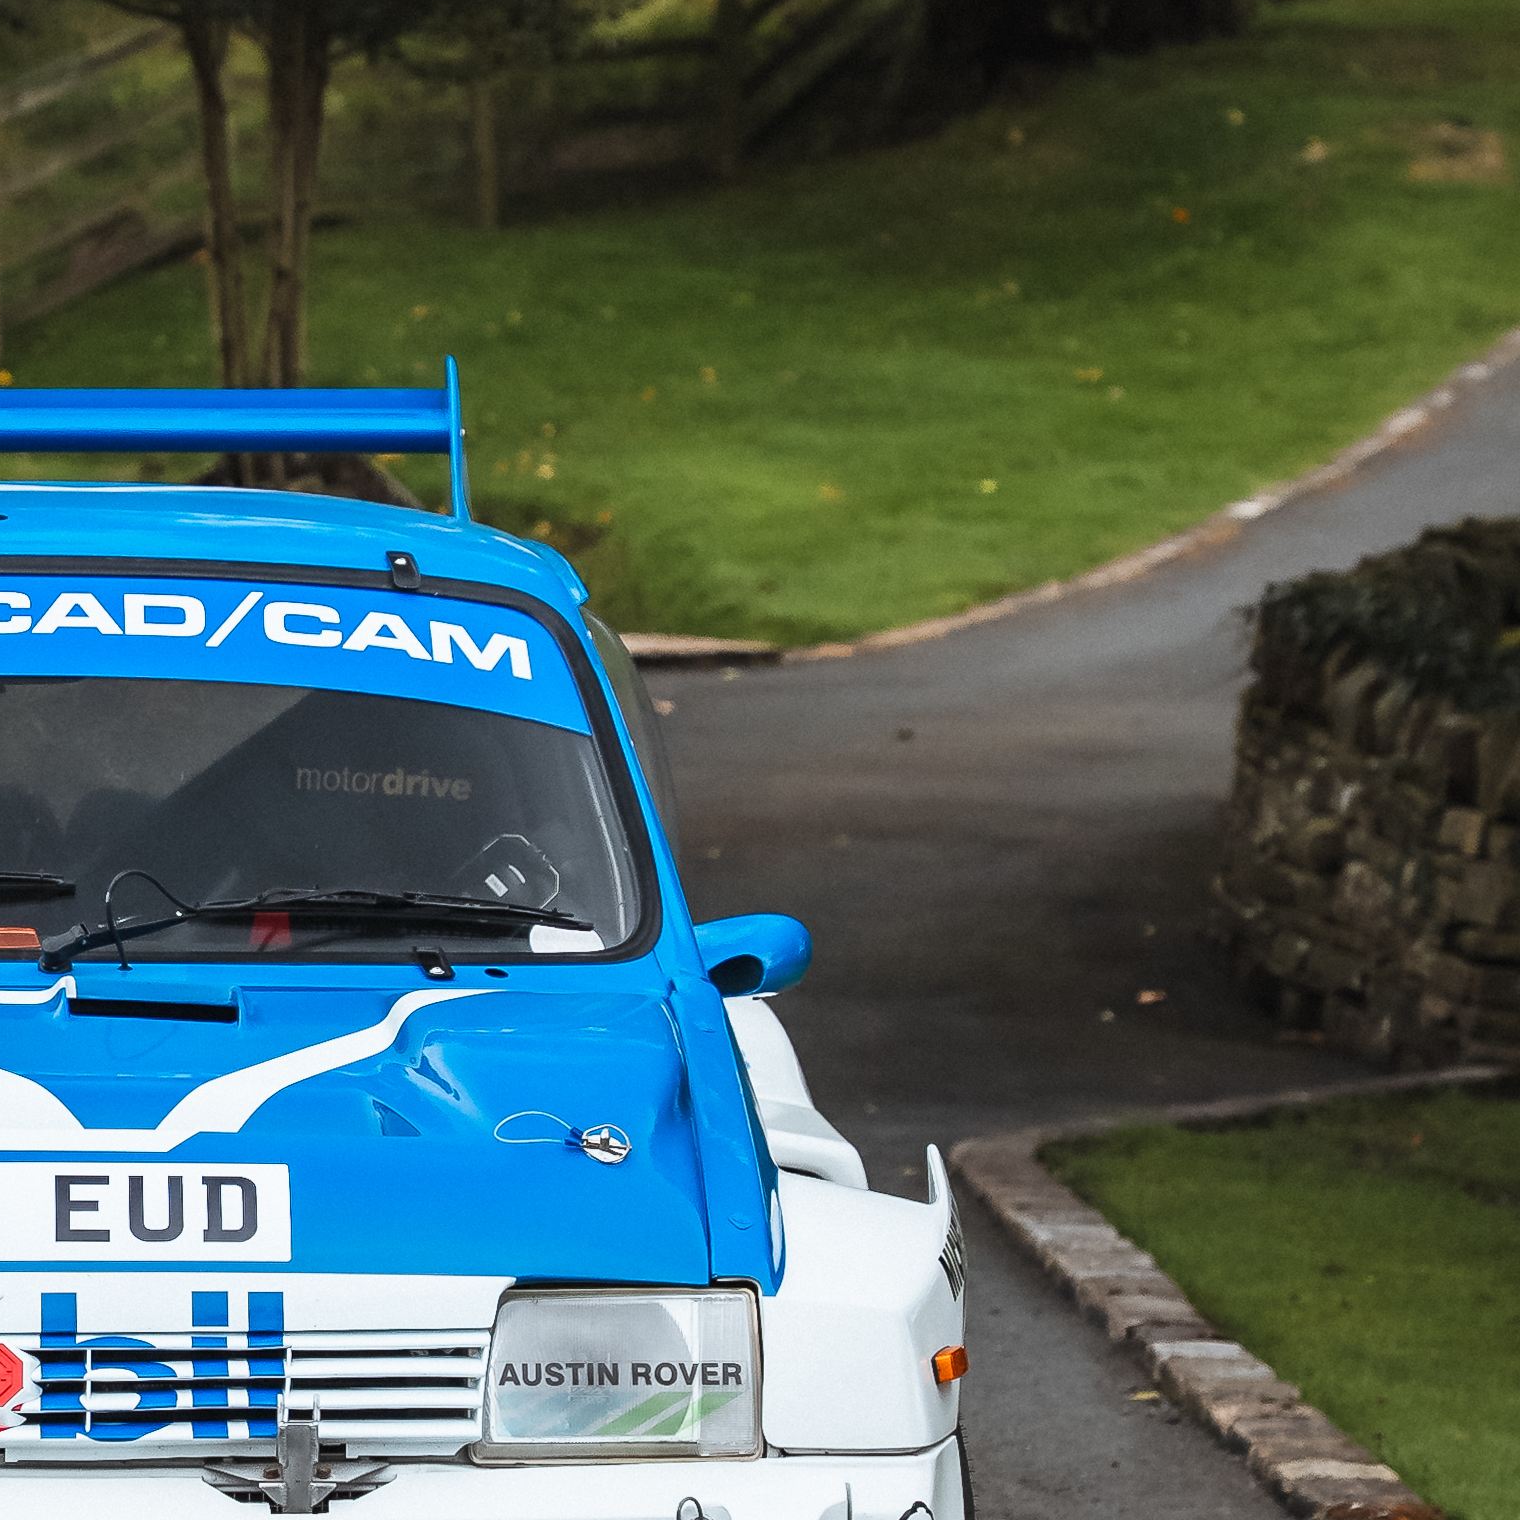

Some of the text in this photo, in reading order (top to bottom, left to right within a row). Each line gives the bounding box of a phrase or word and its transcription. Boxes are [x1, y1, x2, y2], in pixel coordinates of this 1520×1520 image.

[295, 766, 473, 801] motordrive
[53, 1174, 259, 1244] EUD
[498, 1361, 743, 1387] AUSTIN ROVER
